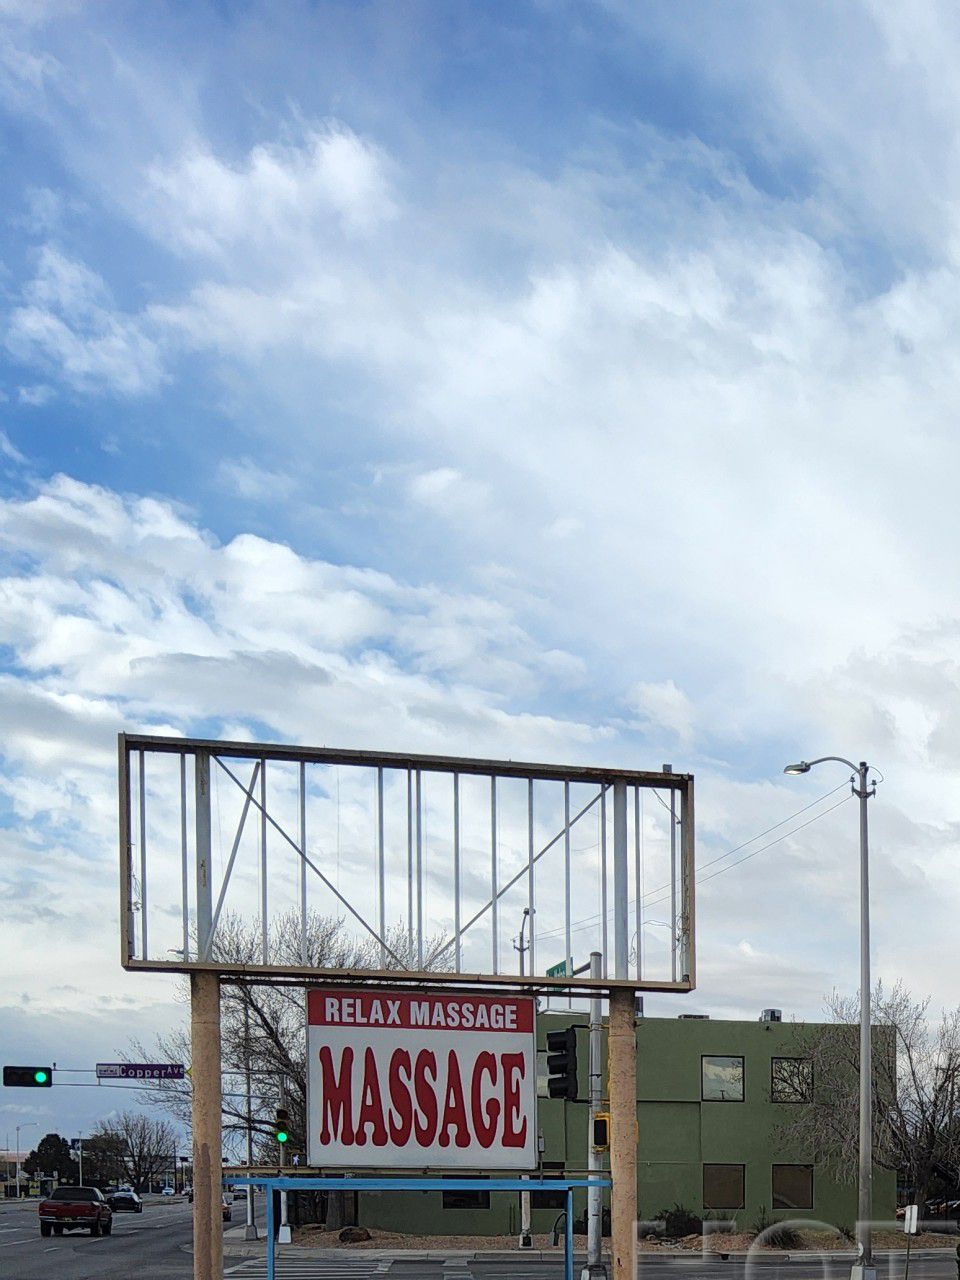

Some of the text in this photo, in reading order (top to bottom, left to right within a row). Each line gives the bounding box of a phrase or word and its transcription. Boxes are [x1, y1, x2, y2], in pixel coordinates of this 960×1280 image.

[325, 998, 517, 1030] RELAX MASSAGE
[120, 1066, 166, 1077] Copper
[319, 1046, 527, 1149] MASSAGE
